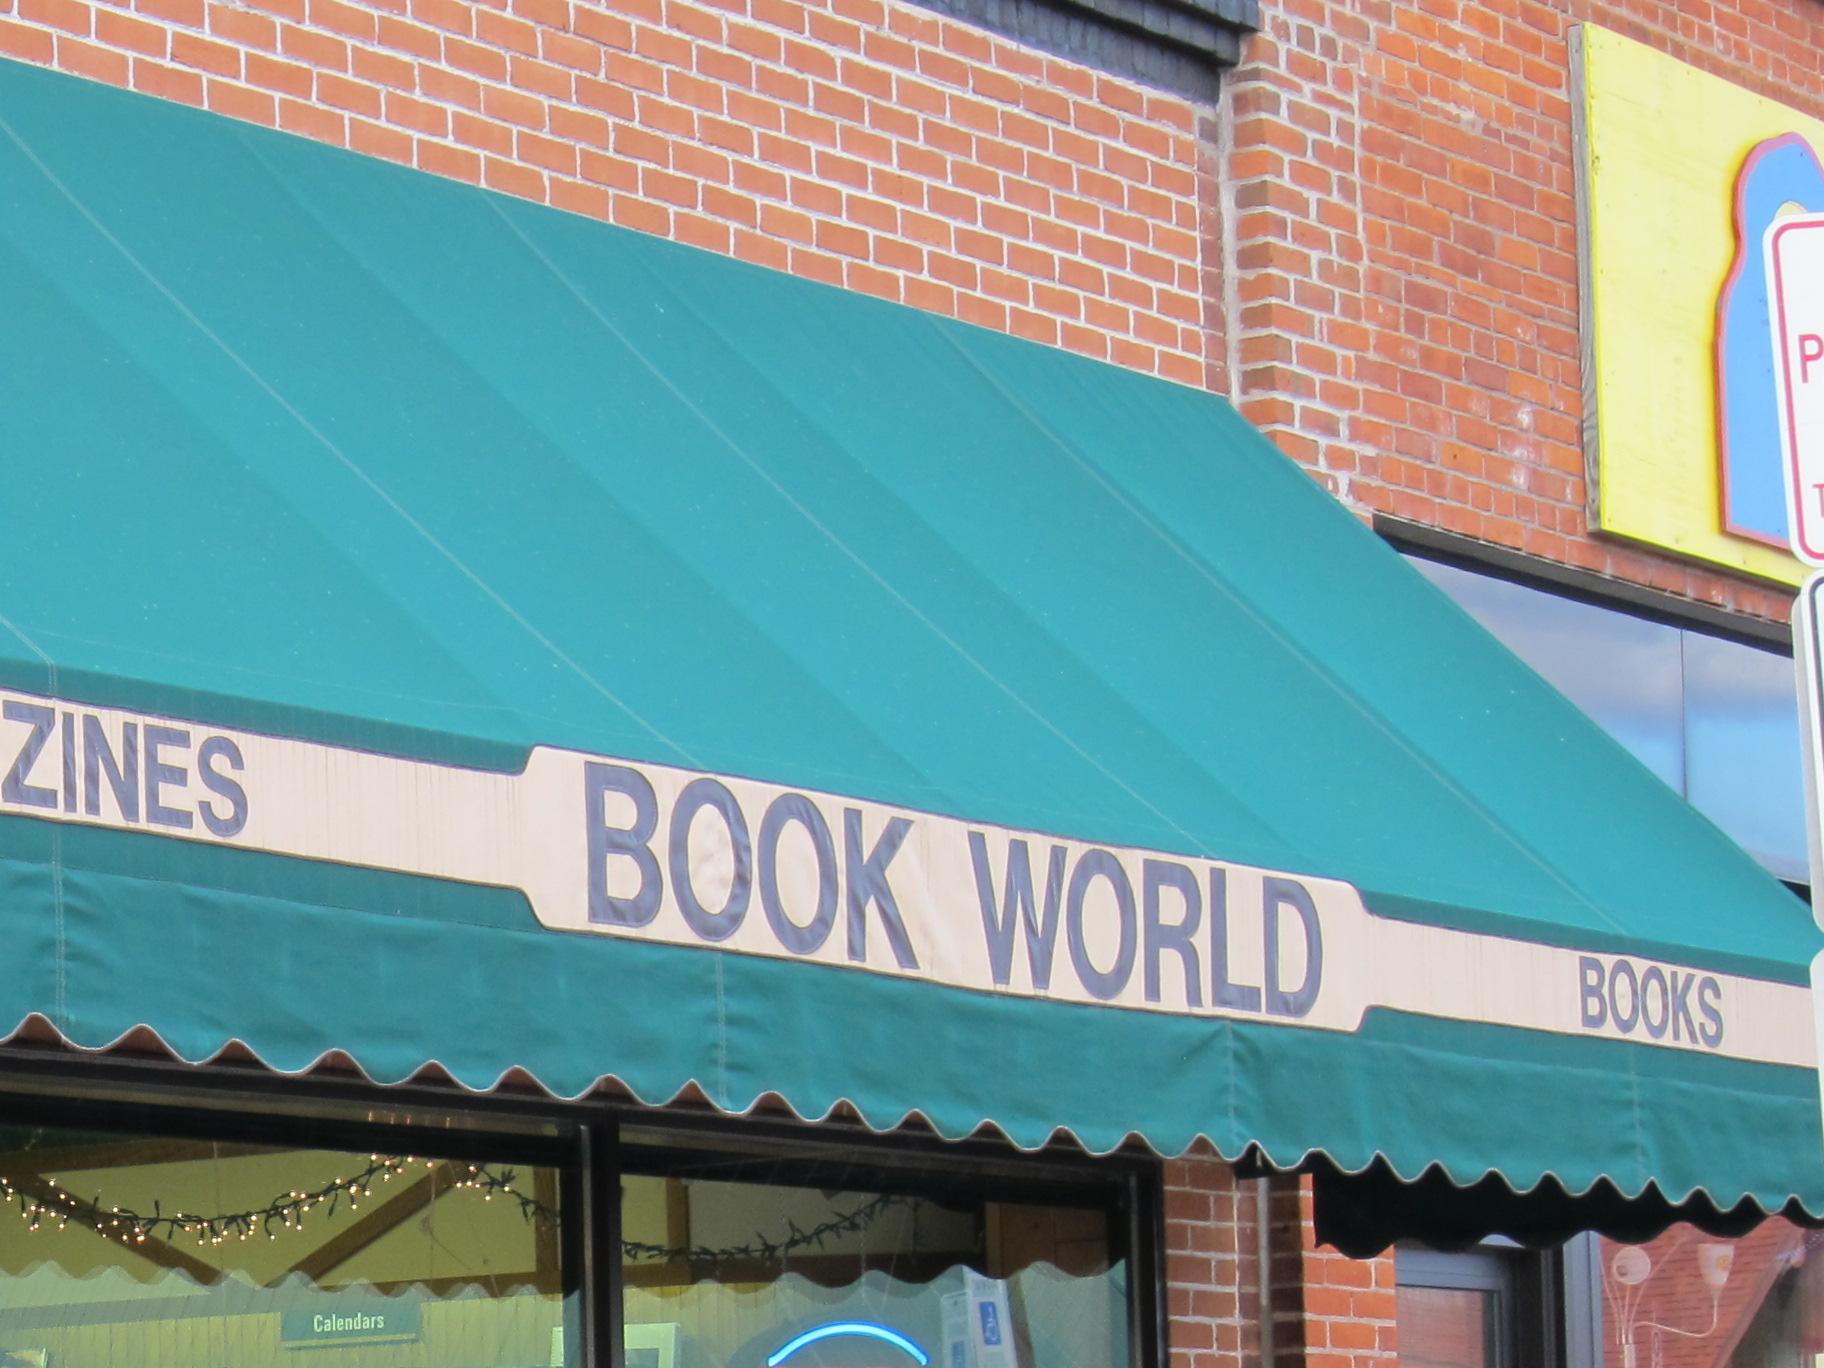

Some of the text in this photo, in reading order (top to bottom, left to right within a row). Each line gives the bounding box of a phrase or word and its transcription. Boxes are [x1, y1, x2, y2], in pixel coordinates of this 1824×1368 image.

[584, 760, 1323, 1018] BOOK WORLD
[1579, 956, 1724, 1048] BOOKS
[313, 1312, 385, 1333] Calendars
